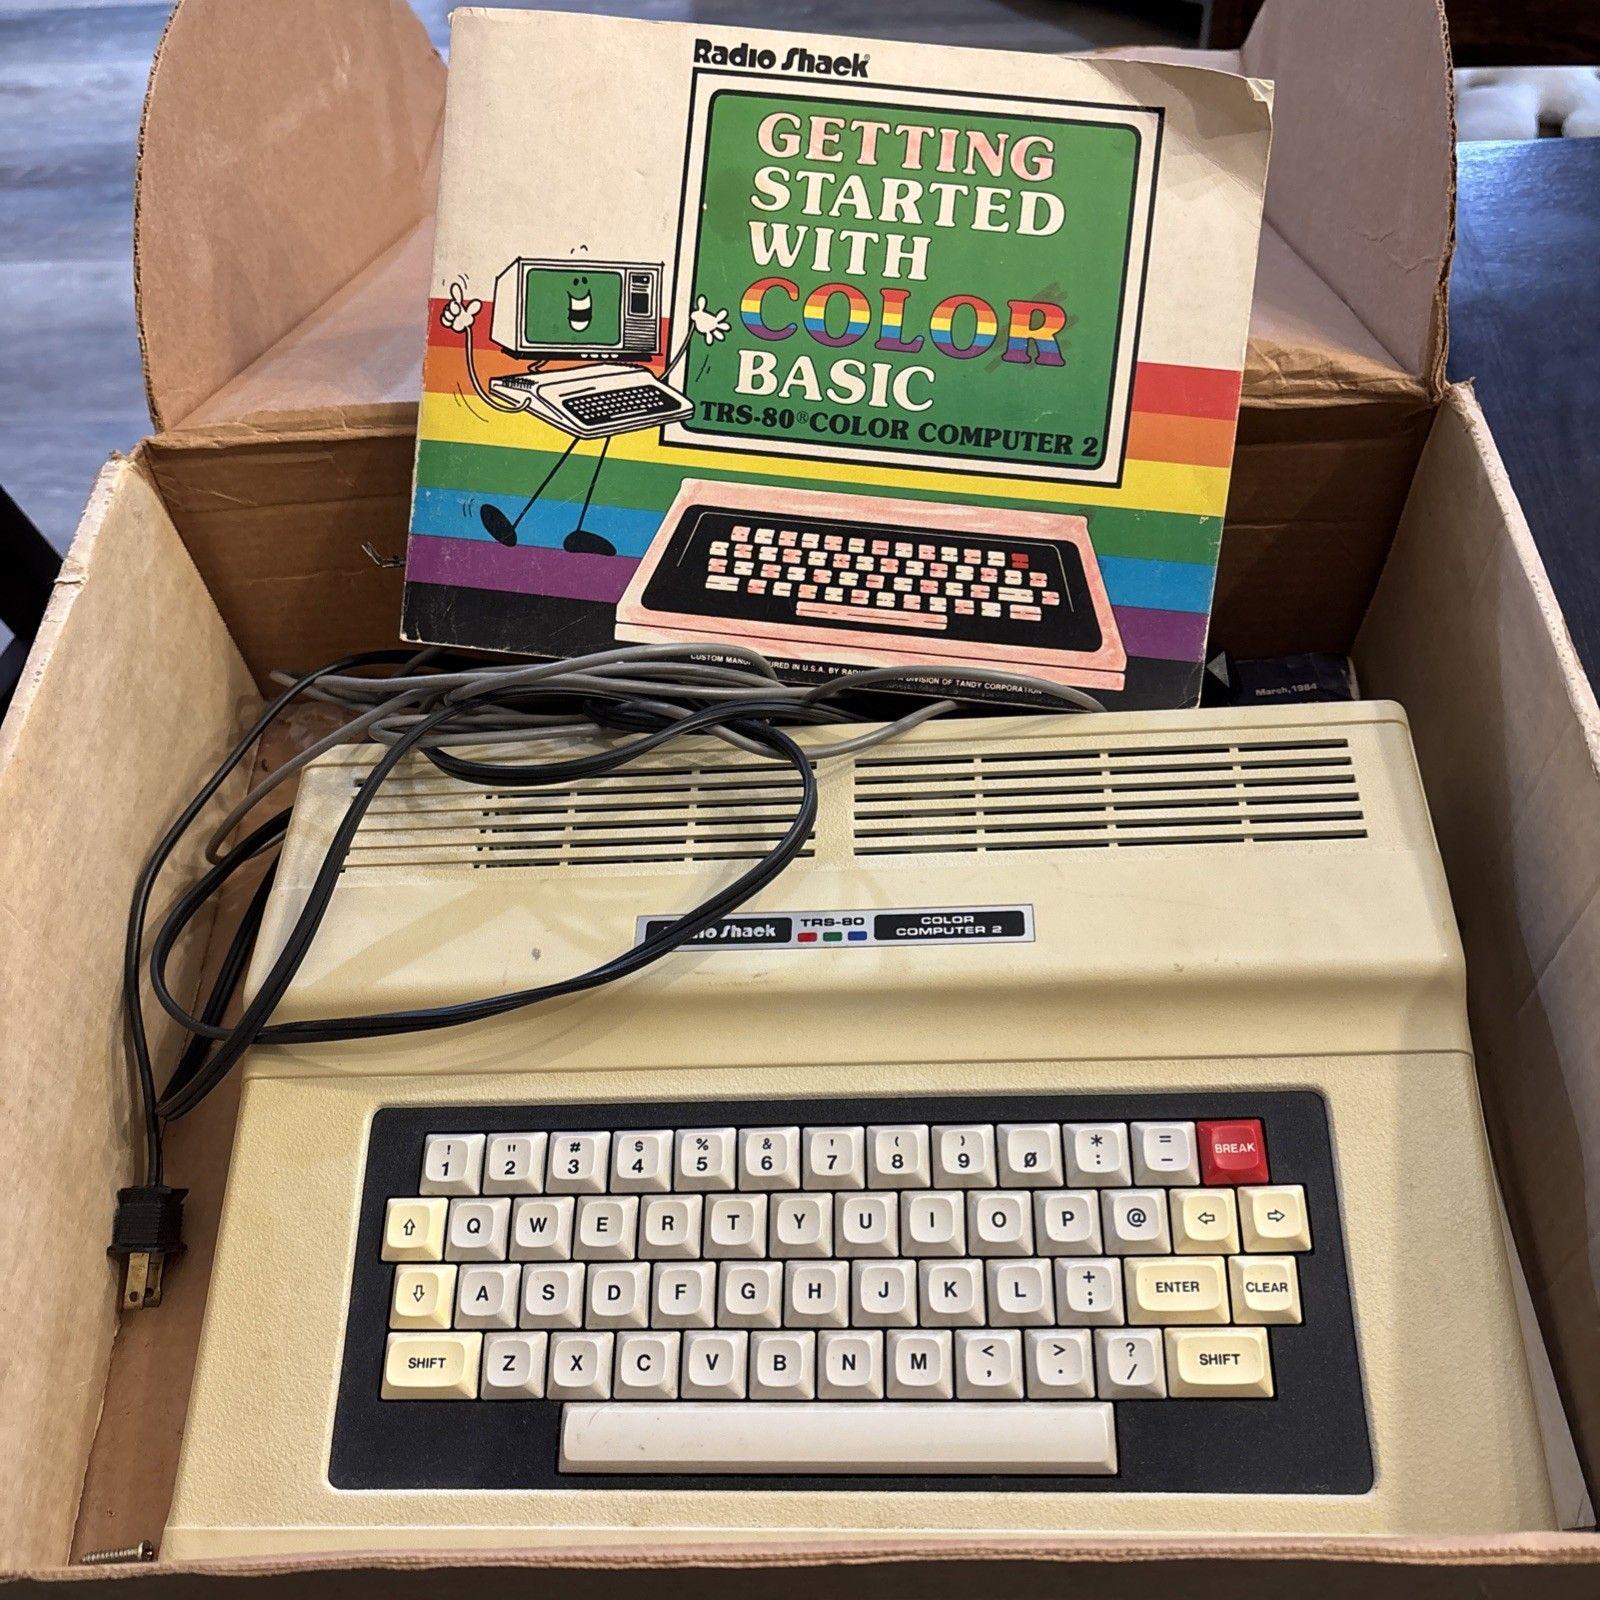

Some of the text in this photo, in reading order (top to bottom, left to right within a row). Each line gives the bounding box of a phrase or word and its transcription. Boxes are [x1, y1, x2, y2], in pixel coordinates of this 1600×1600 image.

[694, 38, 776, 70] Radio
[757, 112, 1055, 182] GETTING
[750, 166, 1066, 236] STARTED
[748, 221, 931, 281] WITH
[740, 276, 1066, 367] COLOR
[734, 349, 936, 412] BASIC
[918, 422, 1073, 456] COMPUTER
[1082, 437, 1098, 457] 2
[828, 667, 840, 675] BY
[956, 680, 982, 689] TANDY
[720, 923, 776, 939] Shack
[800, 917, 865, 928] TRS-80
[896, 925, 1002, 936] COMPUTER 2
[921, 916, 974, 925] COLOR
[441, 1161, 450, 1177] 1
[504, 1160, 516, 1175] 2
[567, 1158, 580, 1175] 3
[631, 1158, 644, 1174] 4
[696, 1156, 708, 1172] 5
[761, 1155, 773, 1171] 6
[826, 1154, 838, 1170] 7
[891, 1153, 904, 1169] 8
[957, 1153, 970, 1169] 9
[1214, 1142, 1256, 1154] BREAK
[466, 1217, 481, 1234] Q
[529, 1217, 548, 1233] W
[596, 1216, 609, 1233] E
[661, 1215, 675, 1231] R
[726, 1214, 740, 1231] T
[793, 1213, 806, 1229] Y
[859, 1212, 872, 1230] U
[929, 1211, 935, 1228] I
[991, 1211, 1007, 1228] O
[1061, 1210, 1075, 1227] P
[475, 1285, 489, 1302] A
[542, 1283, 555, 1301] S
[607, 1284, 621, 1301] D
[675, 1283, 687, 1300] F
[741, 1282, 756, 1300] G
[808, 1282, 822, 1299] H
[878, 1281, 889, 1299] J
[944, 1281, 958, 1298] K
[1014, 1281, 1027, 1298] L
[1155, 1280, 1200, 1293] ENTER
[1245, 1281, 1288, 1293] CLEAR
[407, 1357, 447, 1369] SHIFT
[502, 1354, 516, 1372] Z
[570, 1354, 583, 1372] X
[636, 1353, 652, 1372] C
[705, 1353, 719, 1371] V
[773, 1354, 787, 1372] B
[842, 1353, 856, 1371] N
[910, 1352, 927, 1370] M
[1199, 1353, 1241, 1366] SHIFT
